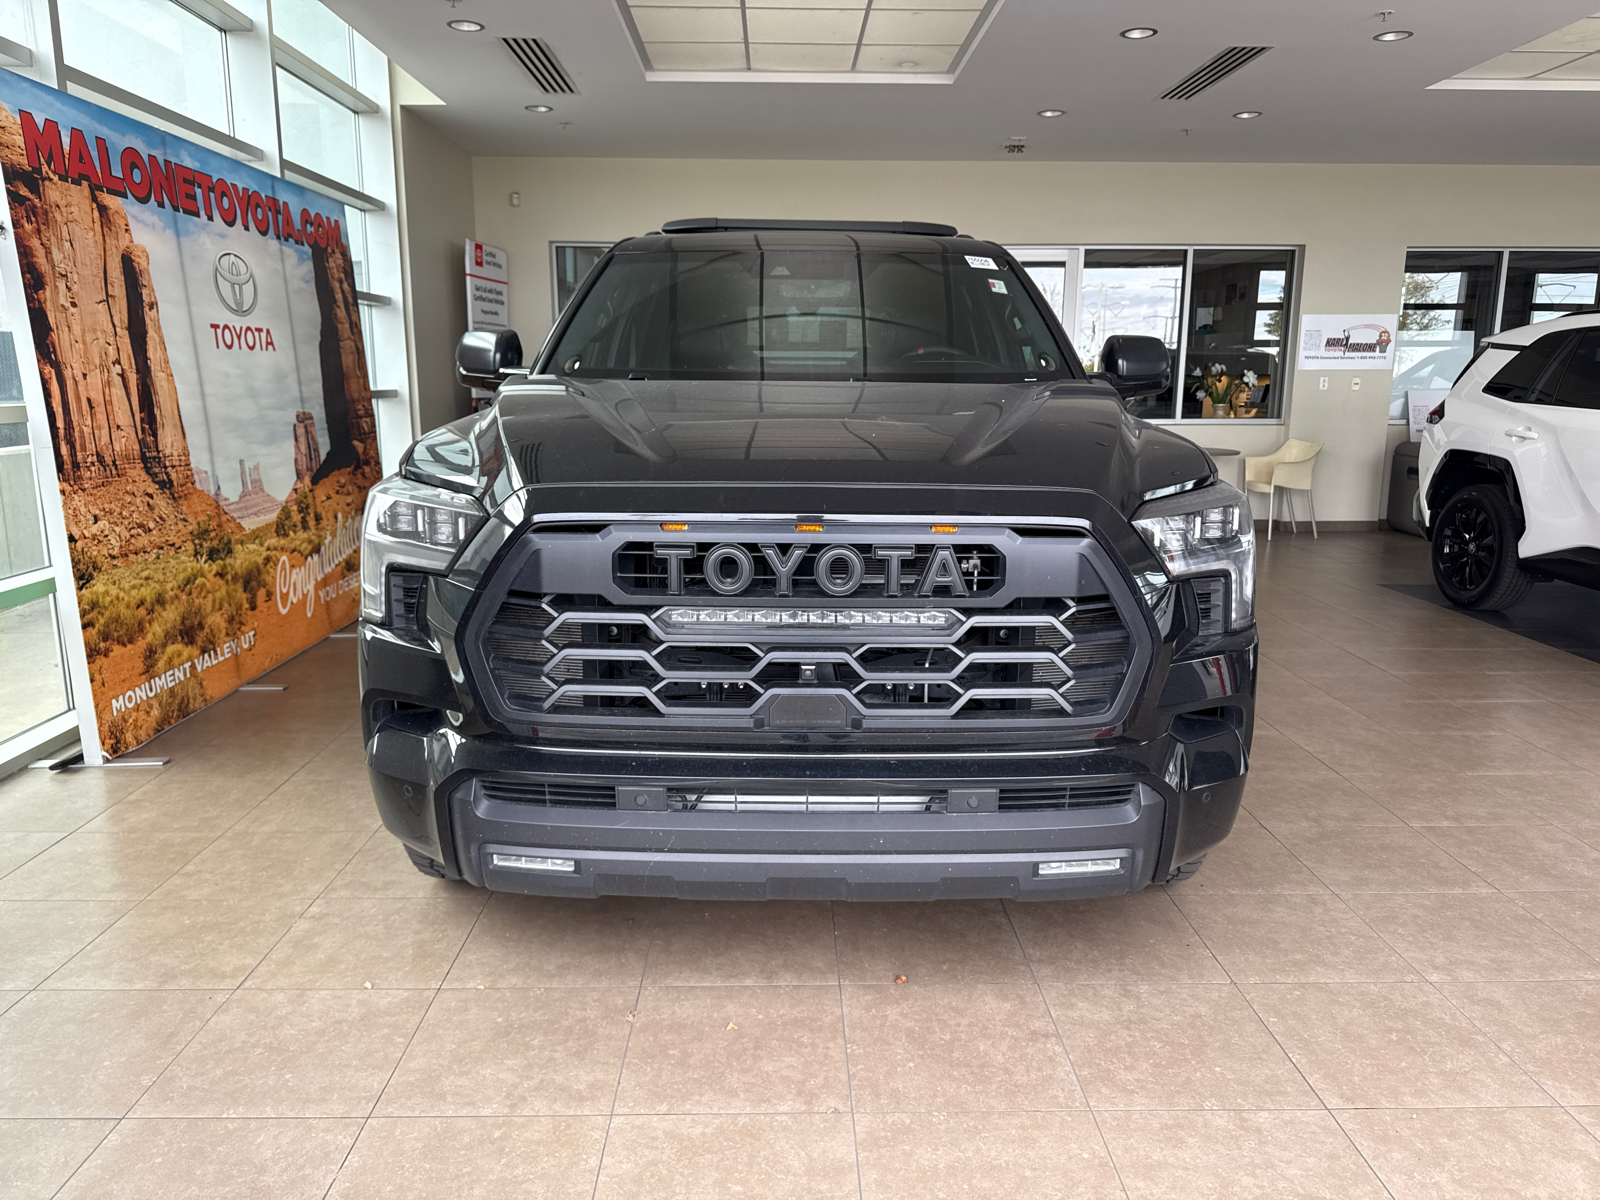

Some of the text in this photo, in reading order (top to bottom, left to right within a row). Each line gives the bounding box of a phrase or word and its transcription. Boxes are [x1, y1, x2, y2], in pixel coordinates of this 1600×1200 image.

[18, 109, 342, 252] MALONETOYOTA.COM
[210, 322, 276, 352] TOYOTA
[1347, 343, 1377, 352] MALONE
[653, 543, 969, 596] TOYOTA
[318, 583, 337, 604] YOU
[111, 630, 256, 716] MONUMENT VALLEY, UT
